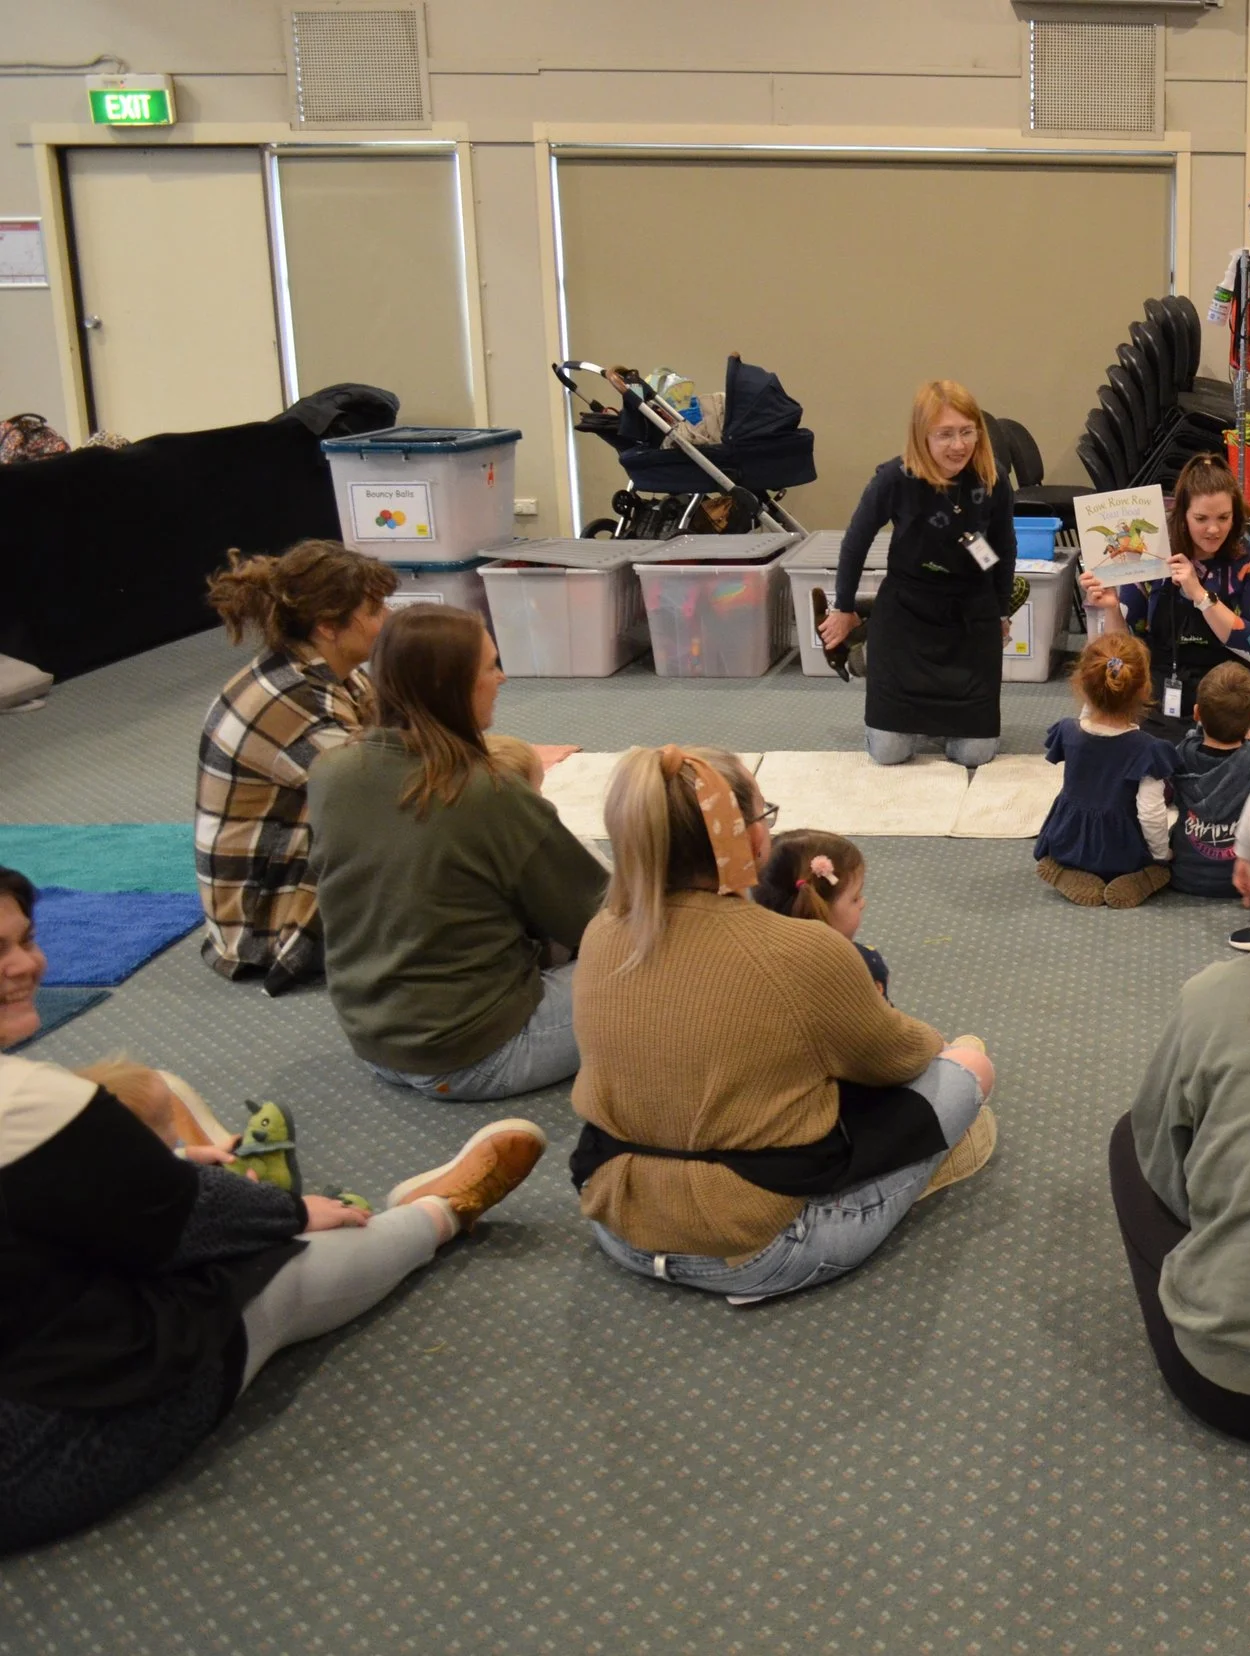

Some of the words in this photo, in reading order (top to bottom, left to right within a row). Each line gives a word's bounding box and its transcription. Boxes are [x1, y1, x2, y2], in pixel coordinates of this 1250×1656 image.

[105, 94, 151, 120] EXIT
[366, 489, 393, 499] Bouncy
[396, 489, 415, 498] Balls
[1131, 495, 1151, 505] Row
